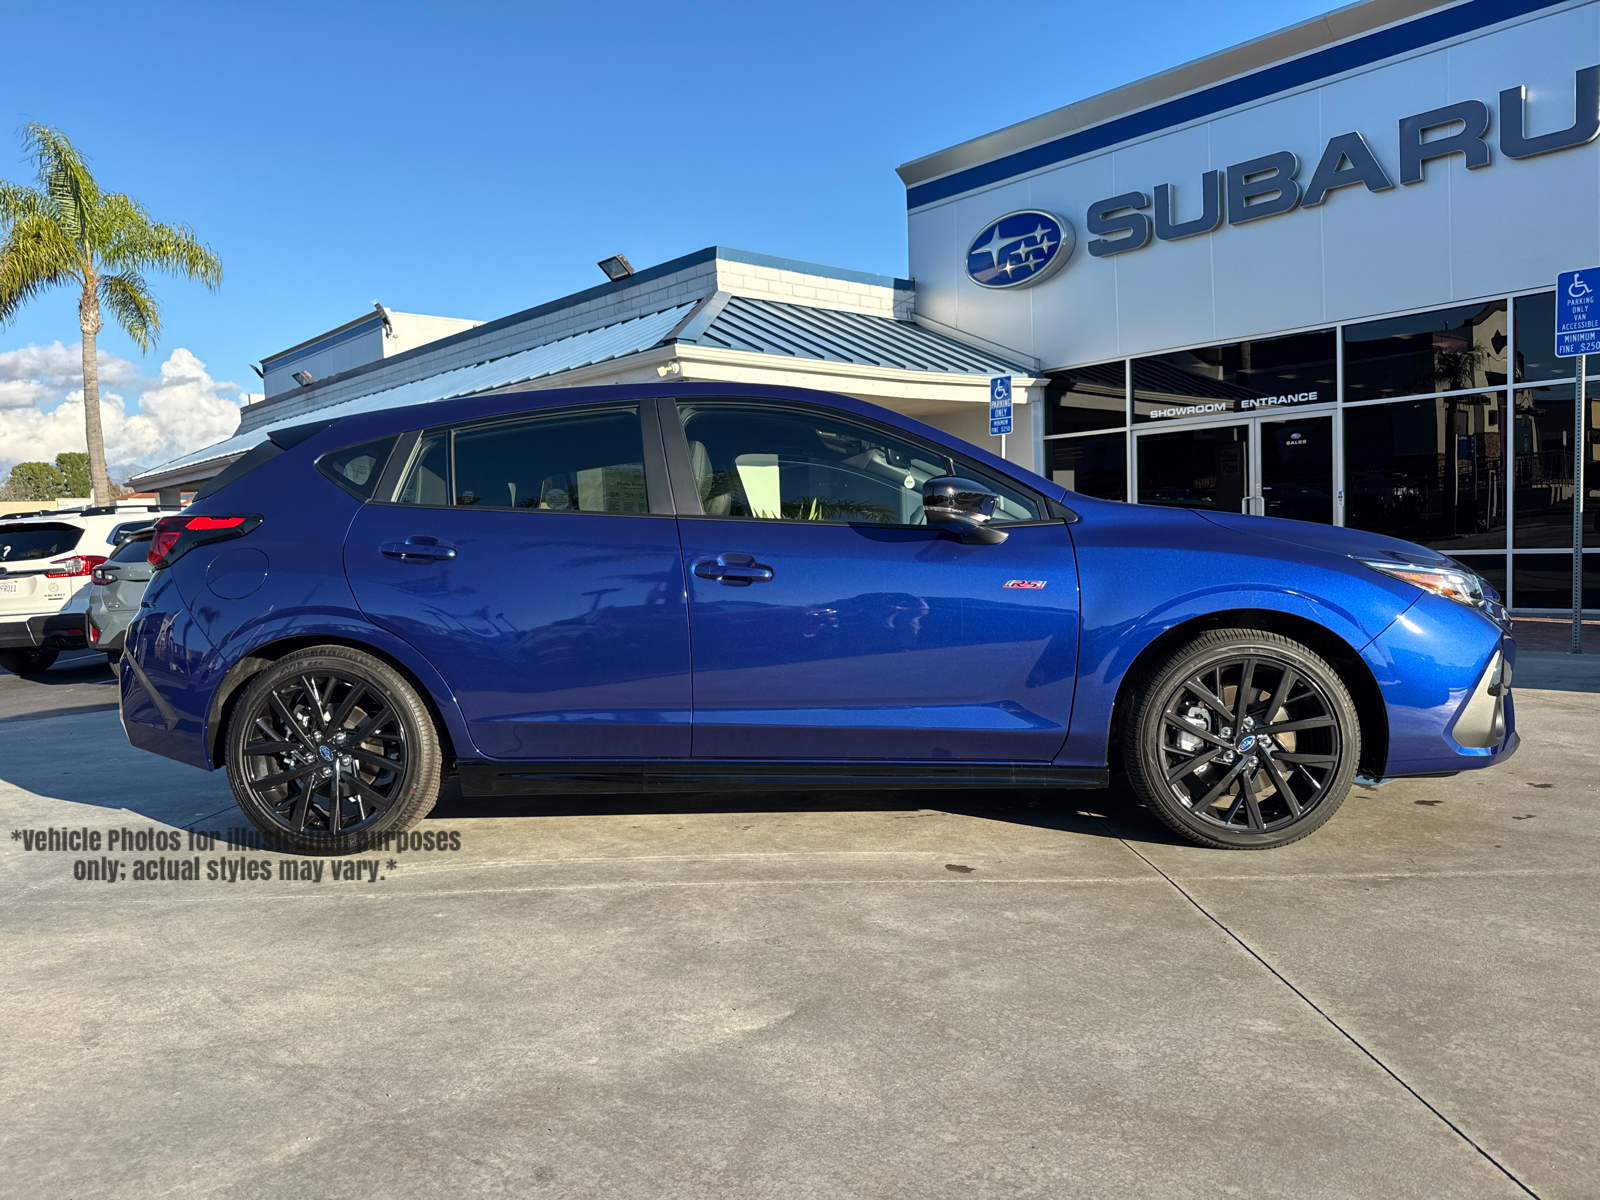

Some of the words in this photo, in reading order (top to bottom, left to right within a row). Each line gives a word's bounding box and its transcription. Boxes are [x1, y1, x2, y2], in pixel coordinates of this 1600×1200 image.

[1086, 64, 1600, 257] SUBARU
[1567, 296, 1594, 306] PARKING
[1572, 305, 1589, 313] ONLY
[1562, 320, 1599, 330] ACCESSIBLE
[1565, 332, 1595, 343] MINIMUM
[1560, 344, 1574, 353] FINE
[1580, 341, 1600, 352] $250
[991, 398, 1010, 408] PARKING
[1150, 402, 1226, 419] SHOWROOM
[1241, 391, 1318, 409] ENTRANCE
[995, 408, 1007, 417] ONLY
